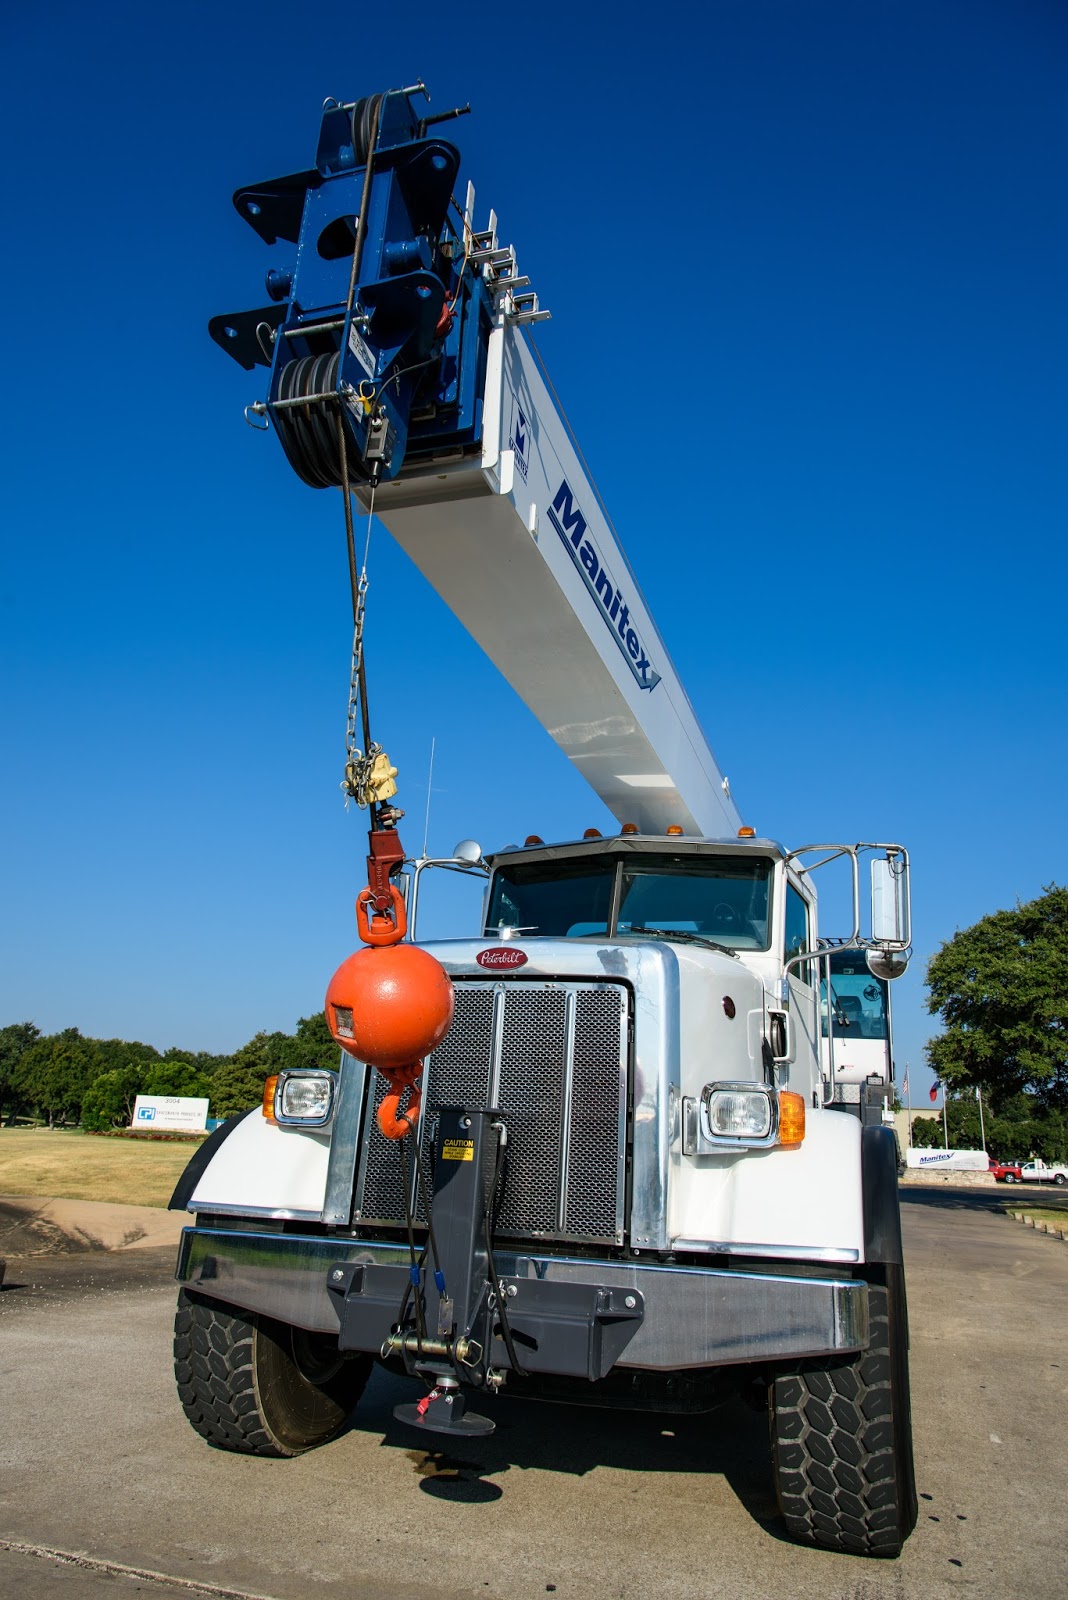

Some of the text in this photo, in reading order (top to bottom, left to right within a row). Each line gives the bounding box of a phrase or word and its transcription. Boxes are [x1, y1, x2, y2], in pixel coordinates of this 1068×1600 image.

[552, 479, 650, 682] Manitex
[481, 951, 523, 965] Peterbilt
[138, 1107, 155, 1120] CPI
[444, 1139, 474, 1147] CAUTION
[920, 1154, 951, 1163] Manitex
